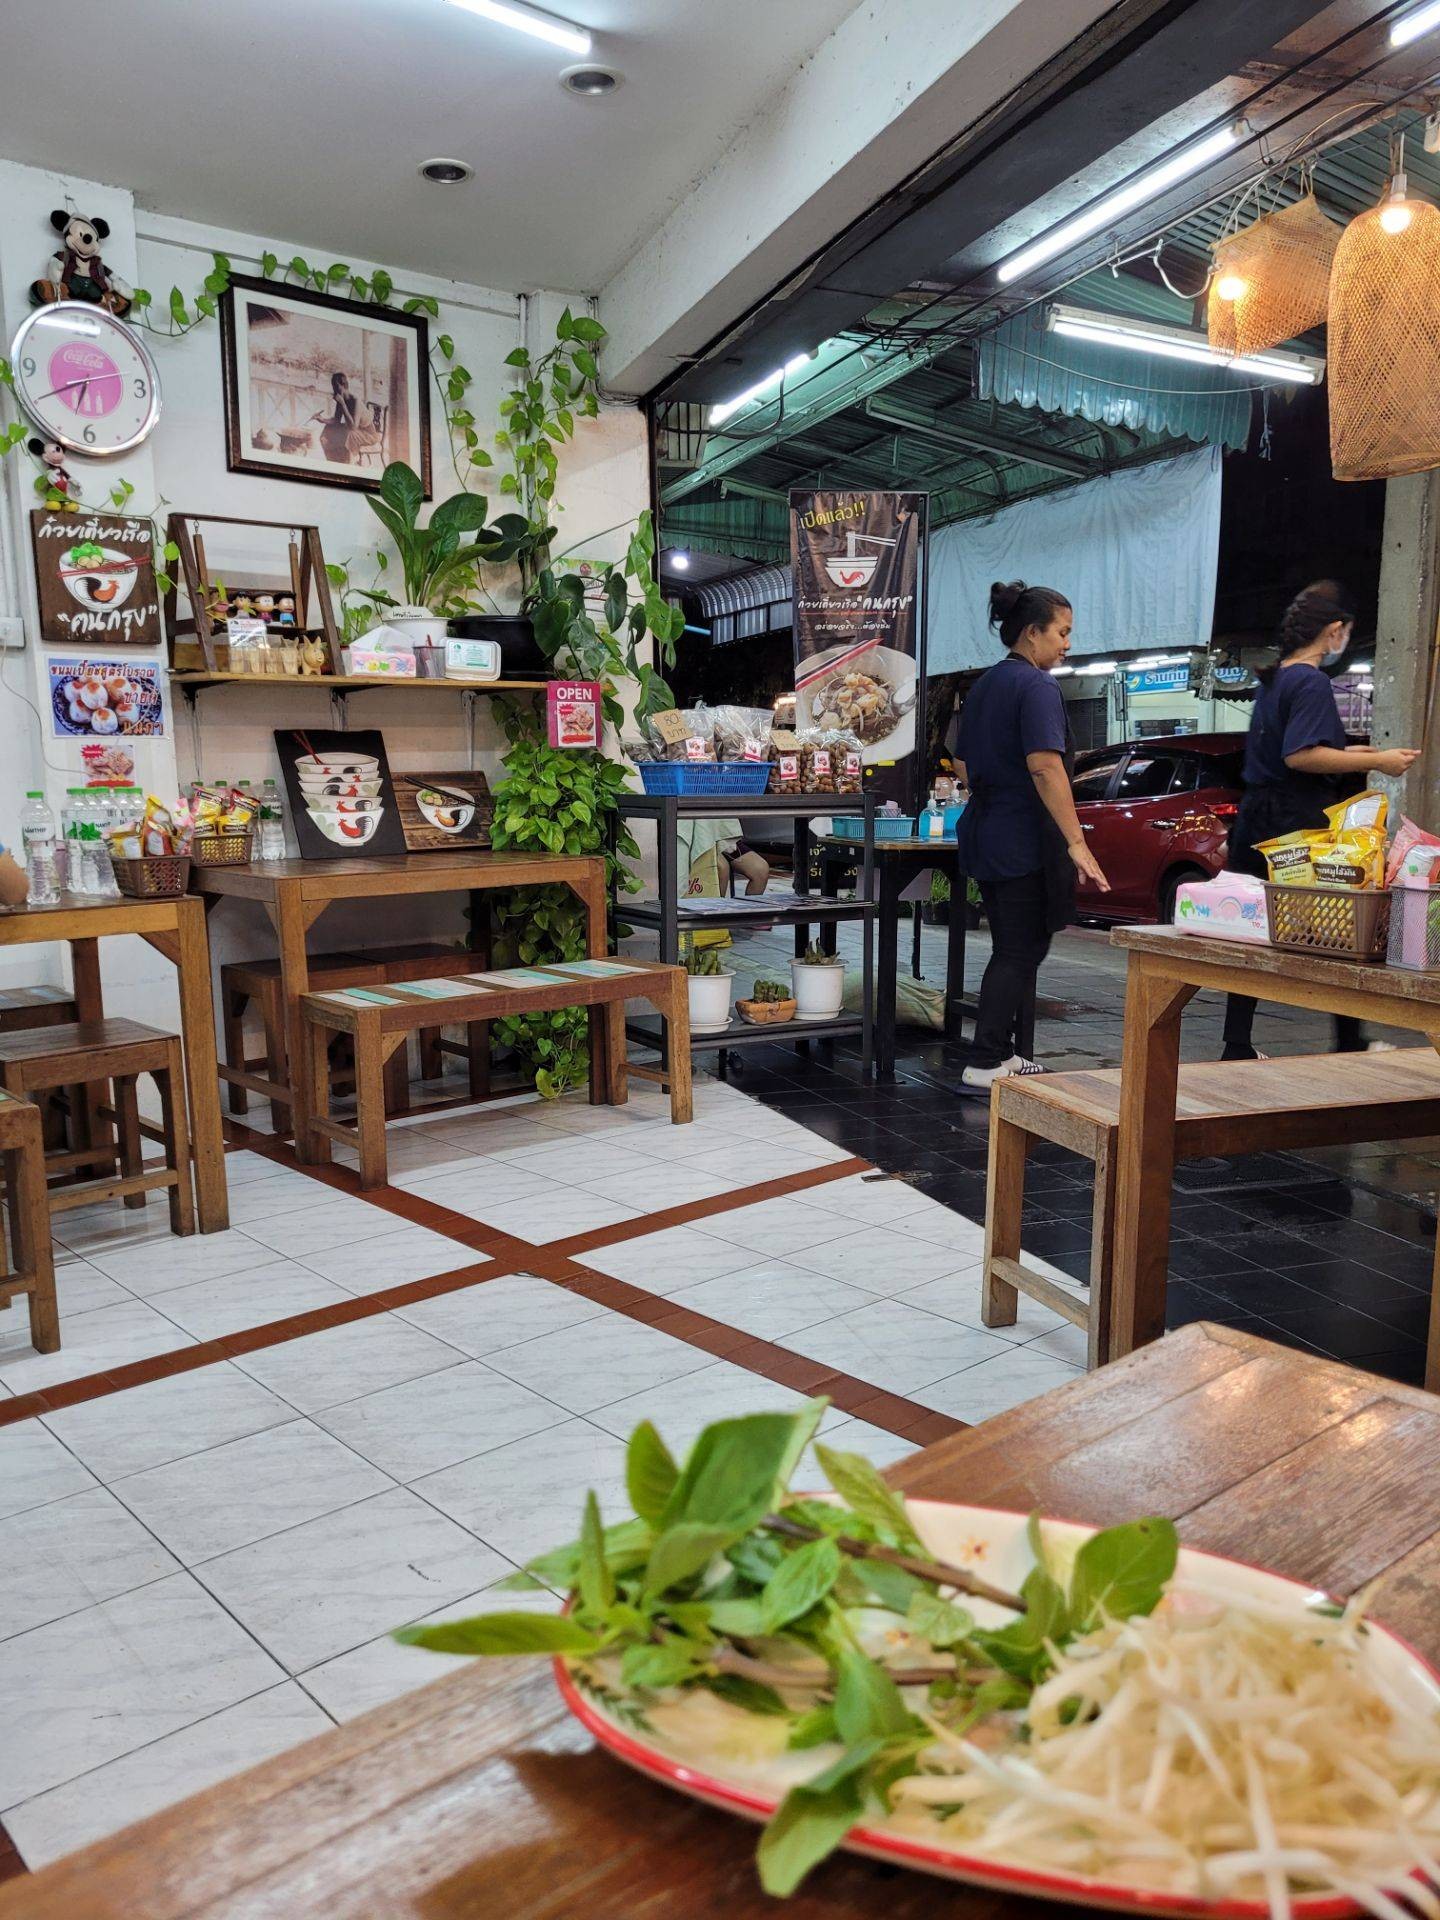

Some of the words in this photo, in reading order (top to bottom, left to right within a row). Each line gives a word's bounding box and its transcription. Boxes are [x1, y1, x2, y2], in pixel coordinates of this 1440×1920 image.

[22, 357, 37, 378] 9
[133, 379, 147, 398] 3
[83, 424, 96, 443] 6
[800, 501, 866, 529] เปิดแล้ว!!
[557, 687, 592, 700] OPEN
